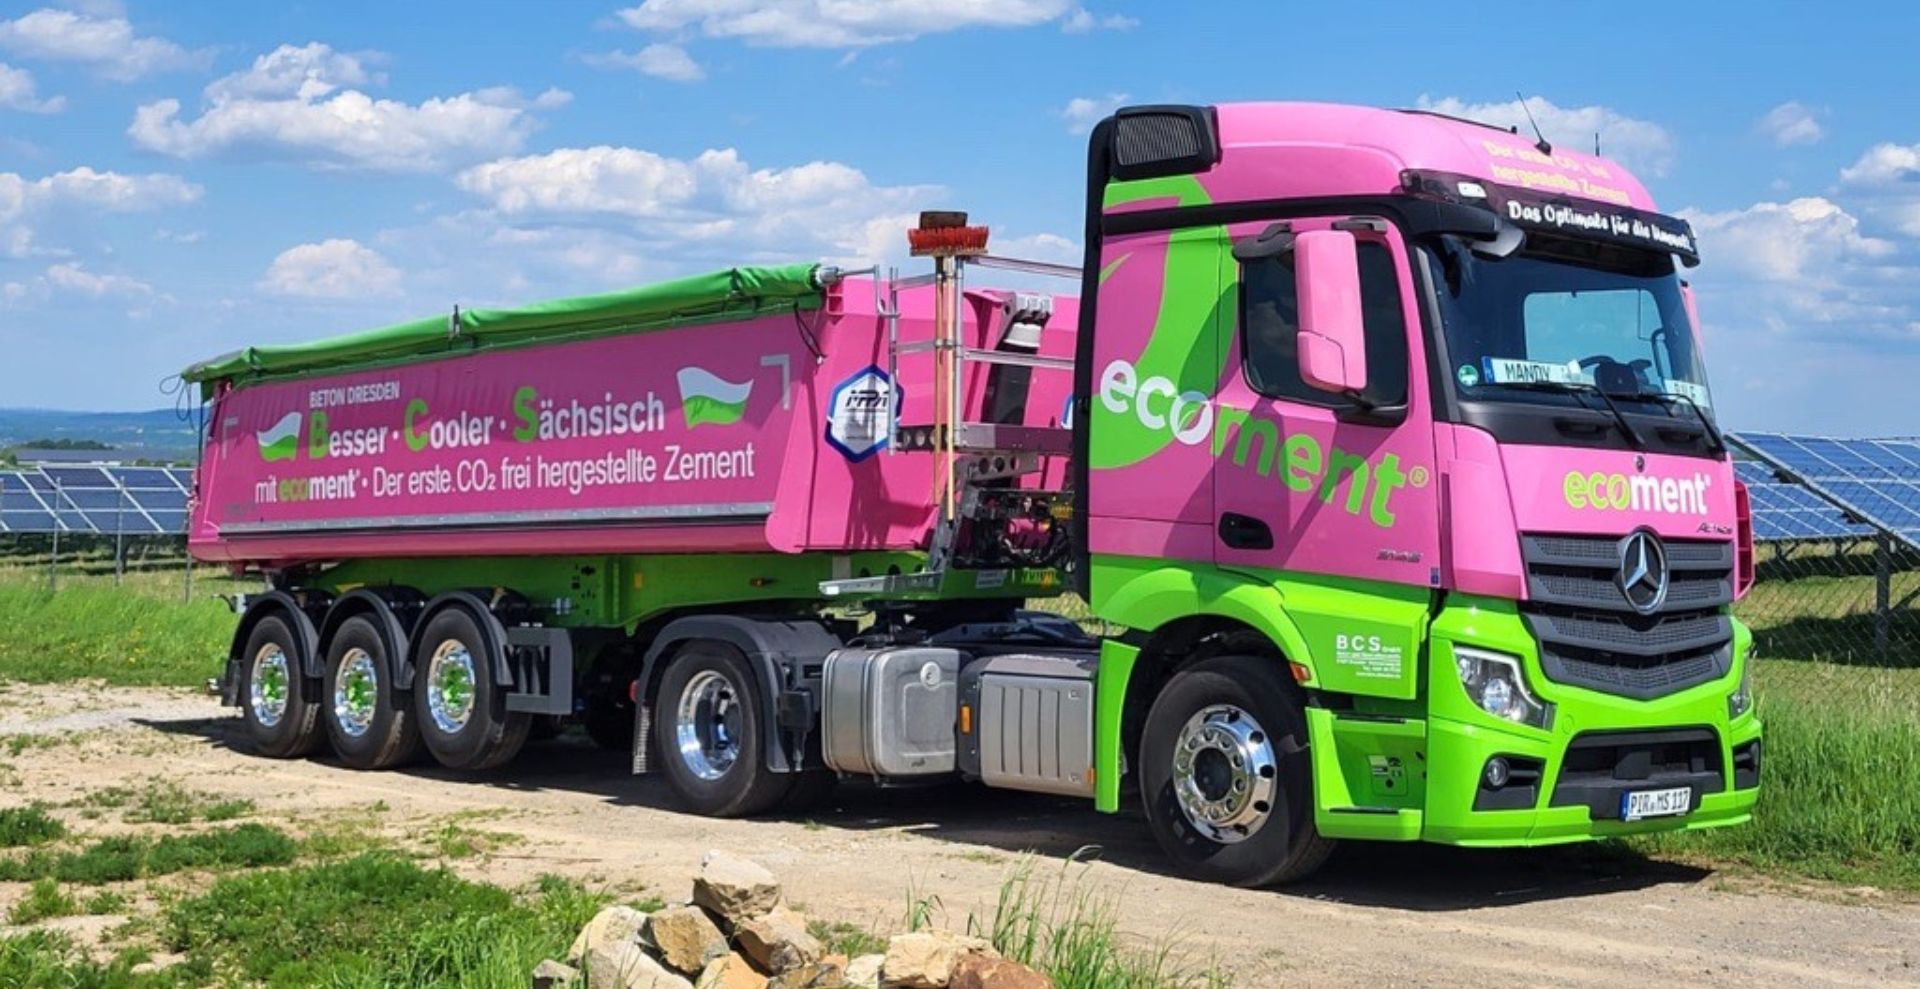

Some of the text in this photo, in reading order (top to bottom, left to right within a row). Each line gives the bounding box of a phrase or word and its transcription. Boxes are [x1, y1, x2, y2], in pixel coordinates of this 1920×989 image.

[1507, 200, 1541, 223] Das
[309, 381, 400, 408] BETON DRESDEN
[308, 386, 664, 458] Besser Cooler Sächsisch
[255, 475, 277, 503] mit
[373, 465, 404, 497] Der
[501, 457, 531, 490] frei
[537, 448, 657, 495] hergestellte
[664, 442, 755, 482] Zement
